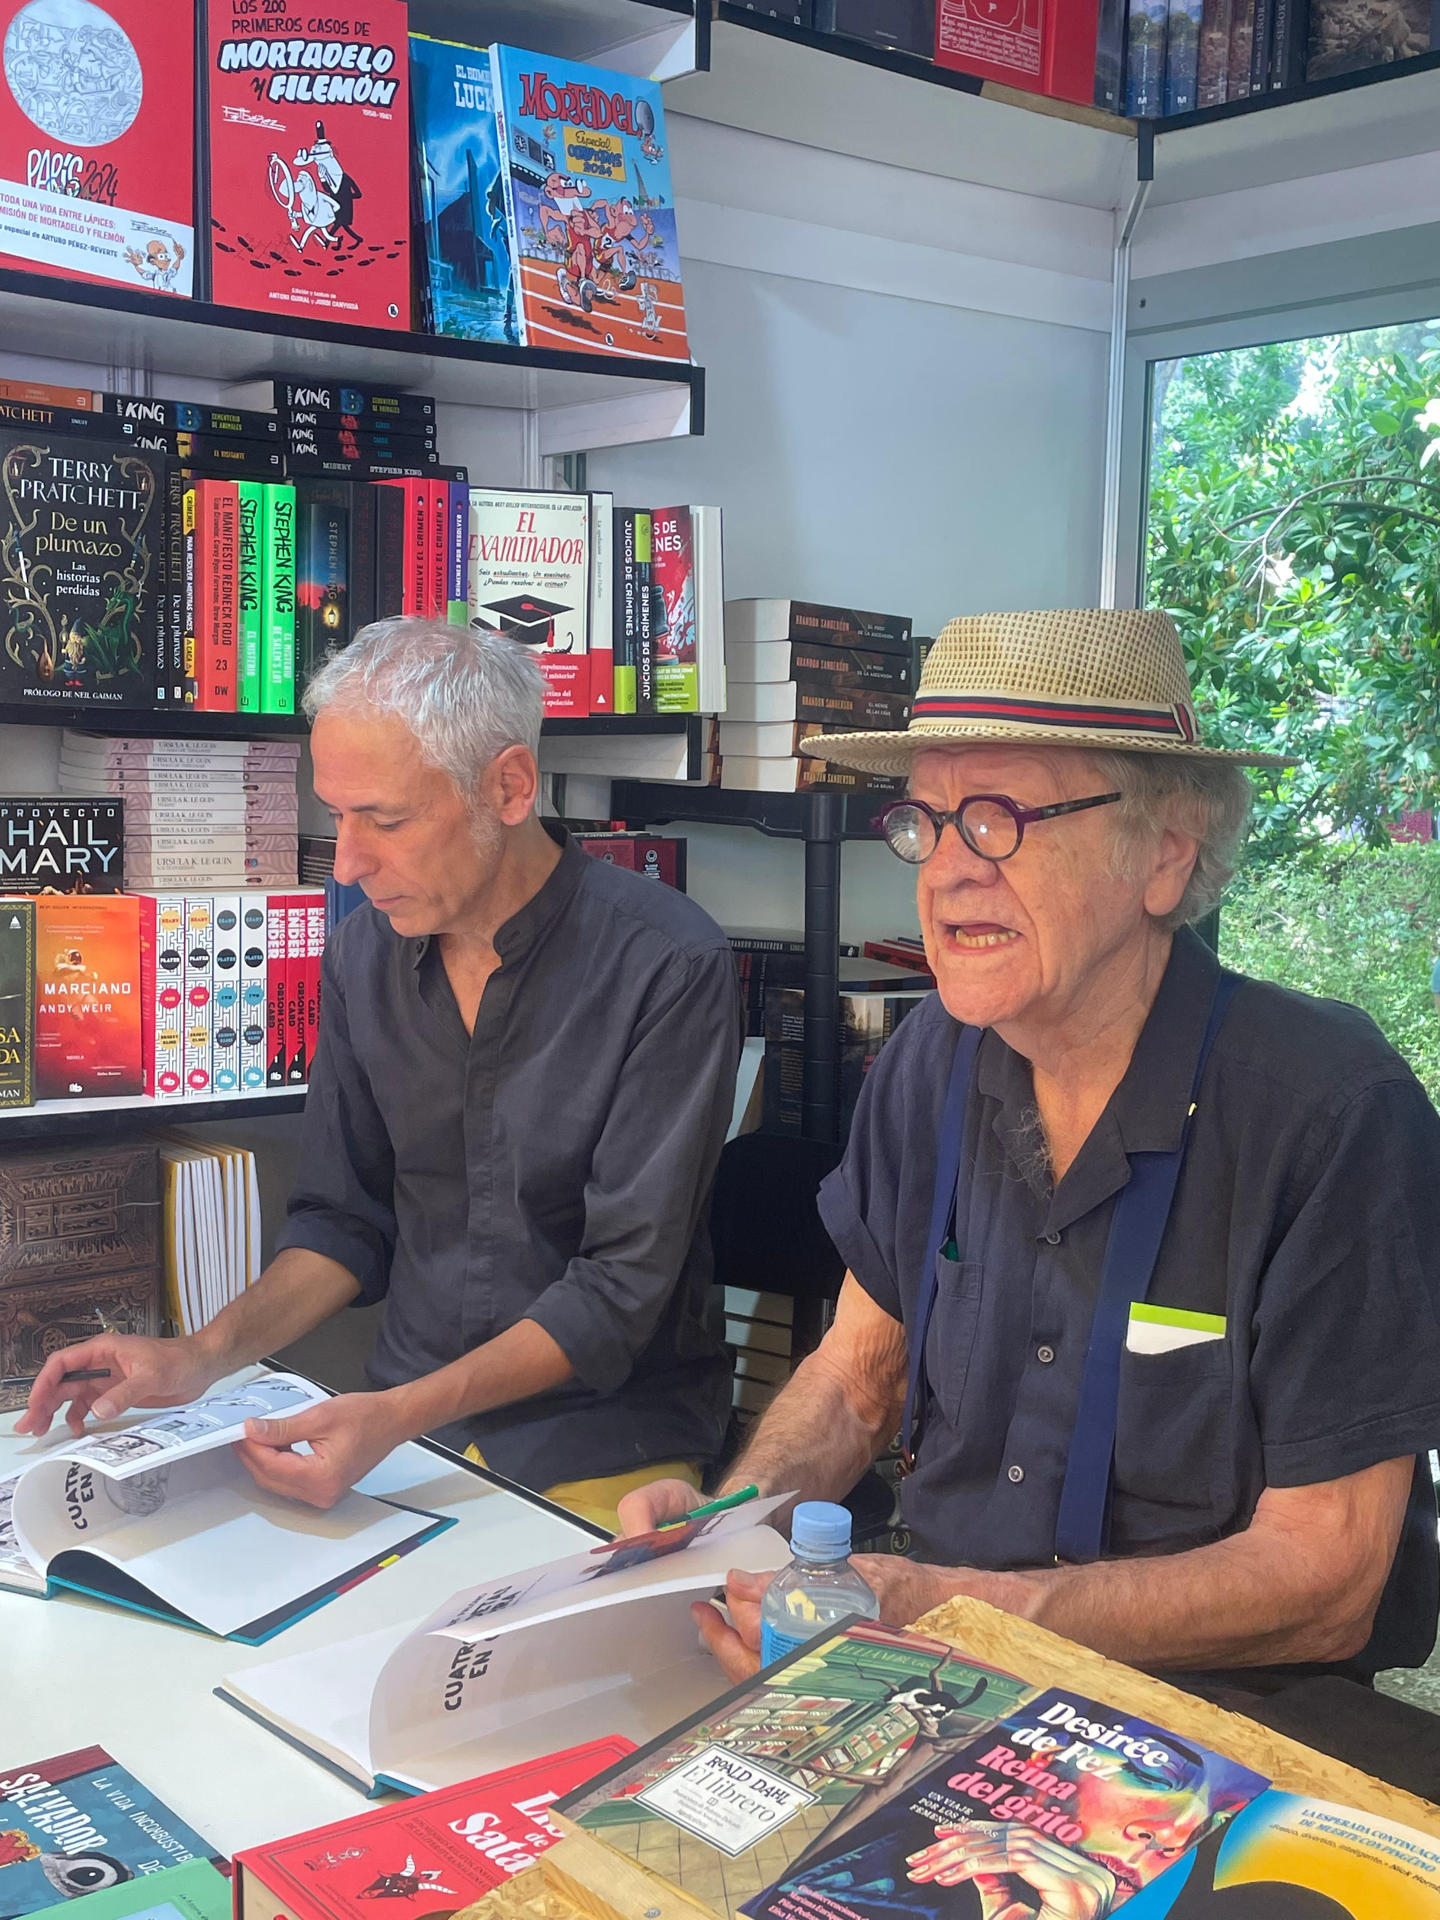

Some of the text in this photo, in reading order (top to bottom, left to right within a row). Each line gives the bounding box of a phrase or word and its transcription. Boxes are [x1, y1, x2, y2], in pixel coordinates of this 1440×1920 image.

[232, 0, 287, 14] LOS 200
[231, 17, 371, 37] PRIMEROS CASOS DE
[218, 38, 396, 75] MORTADELO
[268, 73, 397, 106] FILEMÓN
[22, 198, 39, 211] UNA
[40, 203, 58, 216] VIDA
[58, 208, 83, 223] ENTRE
[28, 213, 40, 224] DE
[39, 216, 85, 235] MORTADELO
[86, 226, 92, 237] Y
[92, 228, 126, 244] FILEMÓN
[41, 233, 67, 247] ARTURO
[295, 388, 331, 409] KING
[125, 401, 166, 426] KING
[296, 411, 318, 426] KING
[291, 427, 315, 441] KING
[296, 443, 319, 456] KING
[48, 456, 114, 484] TERRY
[369, 465, 424, 477] STEPHEN KING
[19, 478, 142, 511] PRATCHETT
[51, 511, 109, 536] De un
[435, 511, 444, 549] CRIMEN
[516, 510, 538, 534] EL
[662, 520, 677, 534] DE
[34, 533, 123, 557] plumazo
[240, 498, 258, 612] STEPHEN KING
[467, 533, 585, 565] EXAMINADOR
[624, 520, 633, 565] JUICIOS
[71, 561, 87, 571] Las
[221, 496, 234, 646] EL MANIFIESTO REDNECK ROJO
[273, 501, 293, 614] STEPHEN KING
[328, 521, 339, 601] STEPHEN KING
[415, 509, 425, 611] RESUELVE EL CRIMEN
[435, 552, 444, 563] EL
[56, 569, 101, 585] historias
[624, 566, 633, 581] DE
[55, 584, 101, 597] perdidas
[625, 582, 634, 637] CRÍMENES
[640, 585, 651, 700] JUICIOS DE CRÍMENES
[215, 658, 228, 671] 23
[22, 687, 124, 701] PRÓLOGO DE NEIL GAIMAN
[1, 808, 115, 818] PROYECTO
[8, 819, 109, 846] HAIL
[0, 847, 118, 875] MARY
[156, 856, 189, 867] URSULA
[212, 856, 232, 867] GUIN
[267, 908, 280, 959] ENDER
[278, 918, 286, 948] JUEGO
[287, 908, 300, 959] ENDER
[298, 918, 306, 947] JUEGO
[307, 907, 319, 958] ENDER
[44, 982, 131, 995] MARCIANO
[39, 1003, 112, 1014] ANDY WEIR
[268, 1001, 276, 1029] CARD
[276, 982, 285, 1046] ORSON SCOTT
[288, 1001, 296, 1028] CARD
[297, 981, 306, 1045] ORSON SCOTT
[307, 999, 315, 1026] CARD
[65, 1461, 89, 1531] CUATR
[80, 1472, 95, 1504] EN
[444, 1640, 478, 1712] CUATR
[468, 1649, 494, 1680] EN
[1036, 1701, 1170, 1769] Desirée
[1009, 1726, 1123, 1782] de Fez
[704, 1755, 792, 1807] ROALD DAHL
[975, 1744, 1078, 1801] Reina
[91, 1776, 110, 1792] LA
[105, 1789, 136, 1812] VIDA
[682, 1764, 715, 1787] El
[704, 1775, 777, 1823] librero
[927, 1790, 975, 1817] UN VIAJE
[946, 1771, 1084, 1844] del grito
[0, 1771, 109, 1857] SALVADOR
[917, 1796, 941, 1811] POR
[937, 1805, 960, 1820] LOS
[1301, 1808, 1316, 1819] LA
[1316, 1812, 1372, 1835] ESPERADA
[523, 1831, 550, 1848] de
[1298, 1818, 1437, 1874] DE MUERTE CON PINGÜINO
